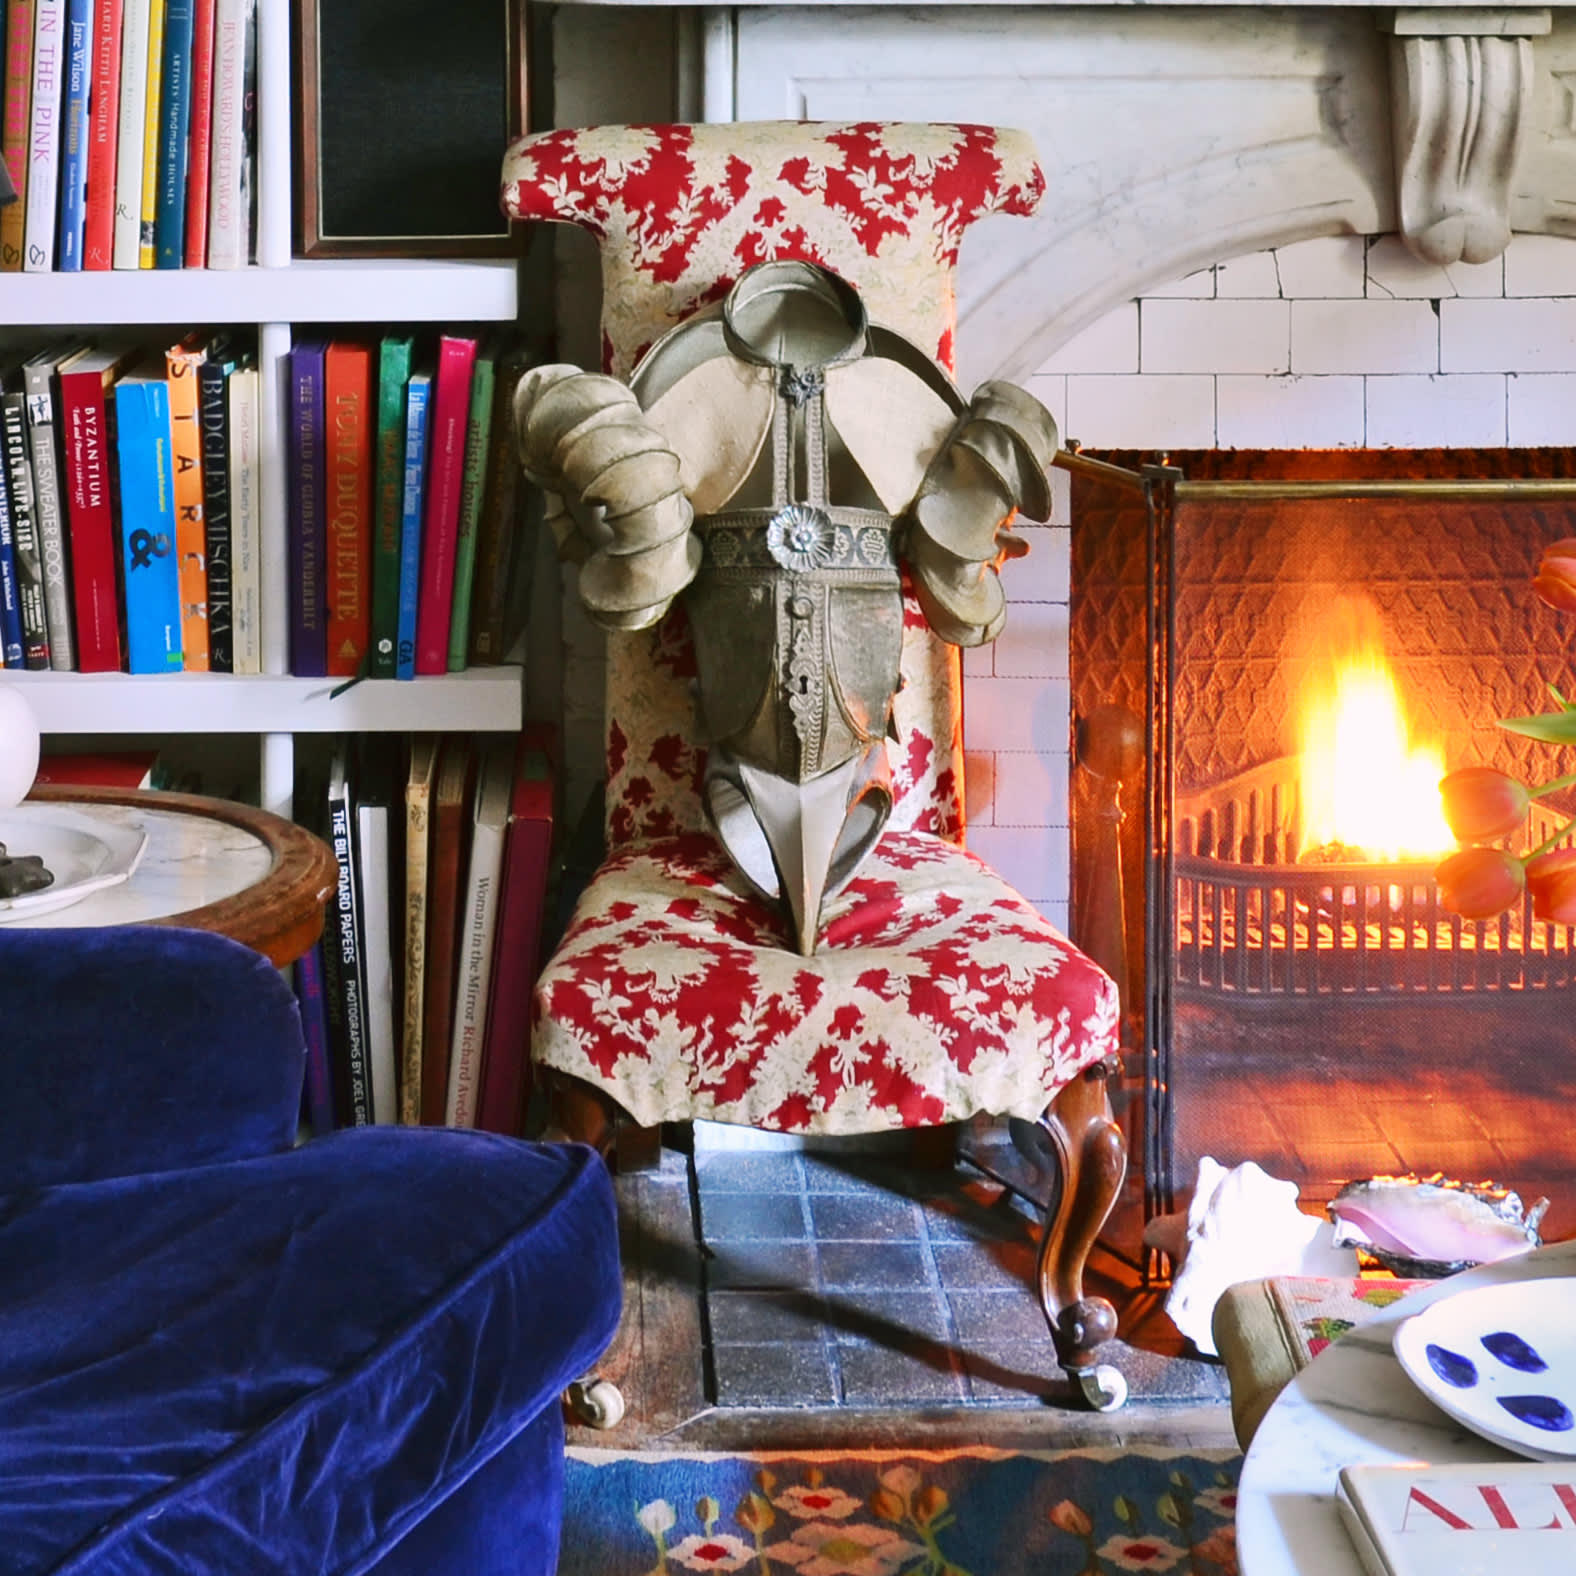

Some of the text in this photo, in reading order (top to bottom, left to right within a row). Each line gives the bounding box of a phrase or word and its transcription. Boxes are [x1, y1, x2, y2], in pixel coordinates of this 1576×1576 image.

[33, 9, 56, 164] IN THE PINK
[71, 21, 85, 92] Jane Wilson
[97, 80, 111, 142] LANGHAM
[100, 36, 112, 76] KEITH
[35, 437, 63, 587] THE SWEATER BOOK
[84, 407, 100, 507] BYZANTIUM
[203, 379, 232, 635] BADGLEY MISCHKA
[335, 392, 359, 621] TONY DUQUETTE
[332, 810, 347, 836] THE
[340, 914, 354, 964] PAPERS
[459, 877, 490, 1081] Woman in the Mirror Richard
